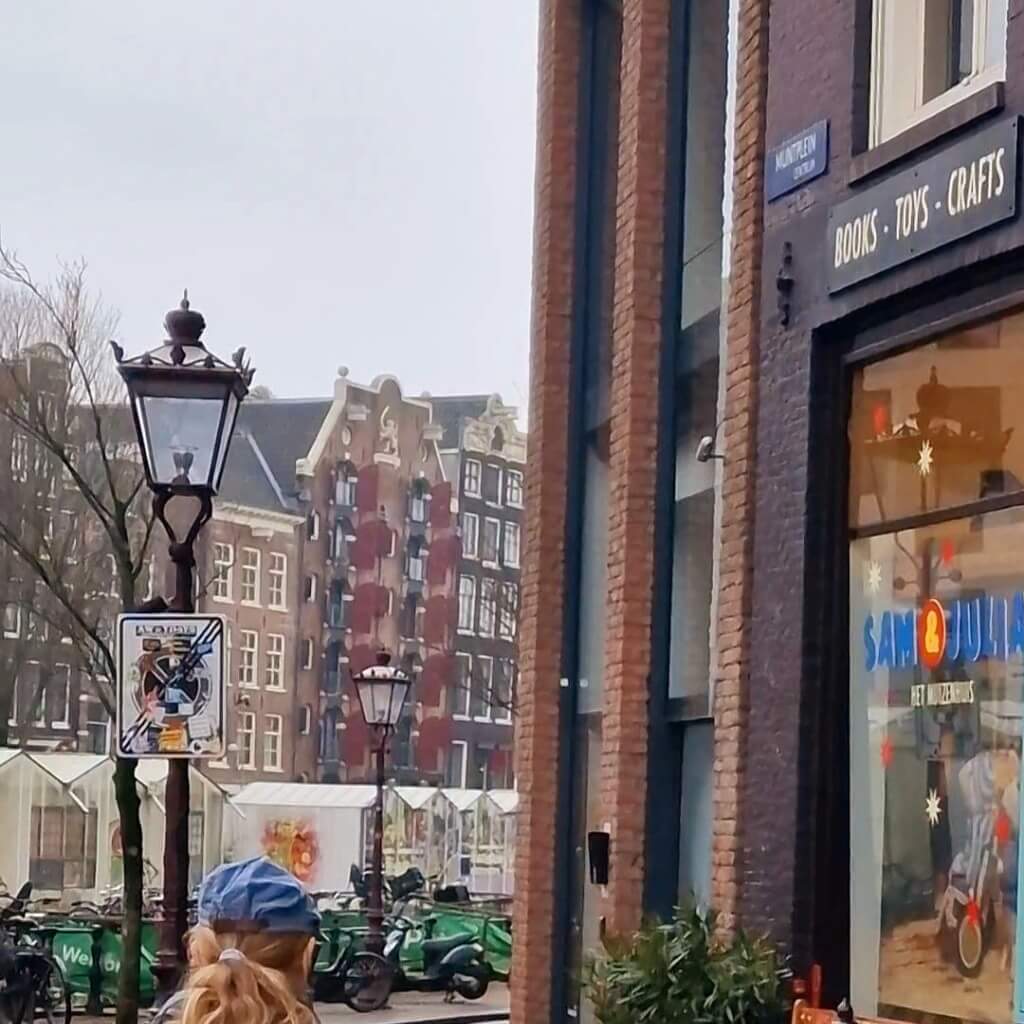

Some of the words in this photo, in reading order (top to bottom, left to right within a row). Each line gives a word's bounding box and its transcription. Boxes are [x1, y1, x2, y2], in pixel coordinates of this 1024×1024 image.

[834, 208, 878, 268] BOOKS
[895, 184, 929, 240] TOYS
[948, 147, 1005, 216] CRAFTS
[864, 607, 918, 672] SAM
